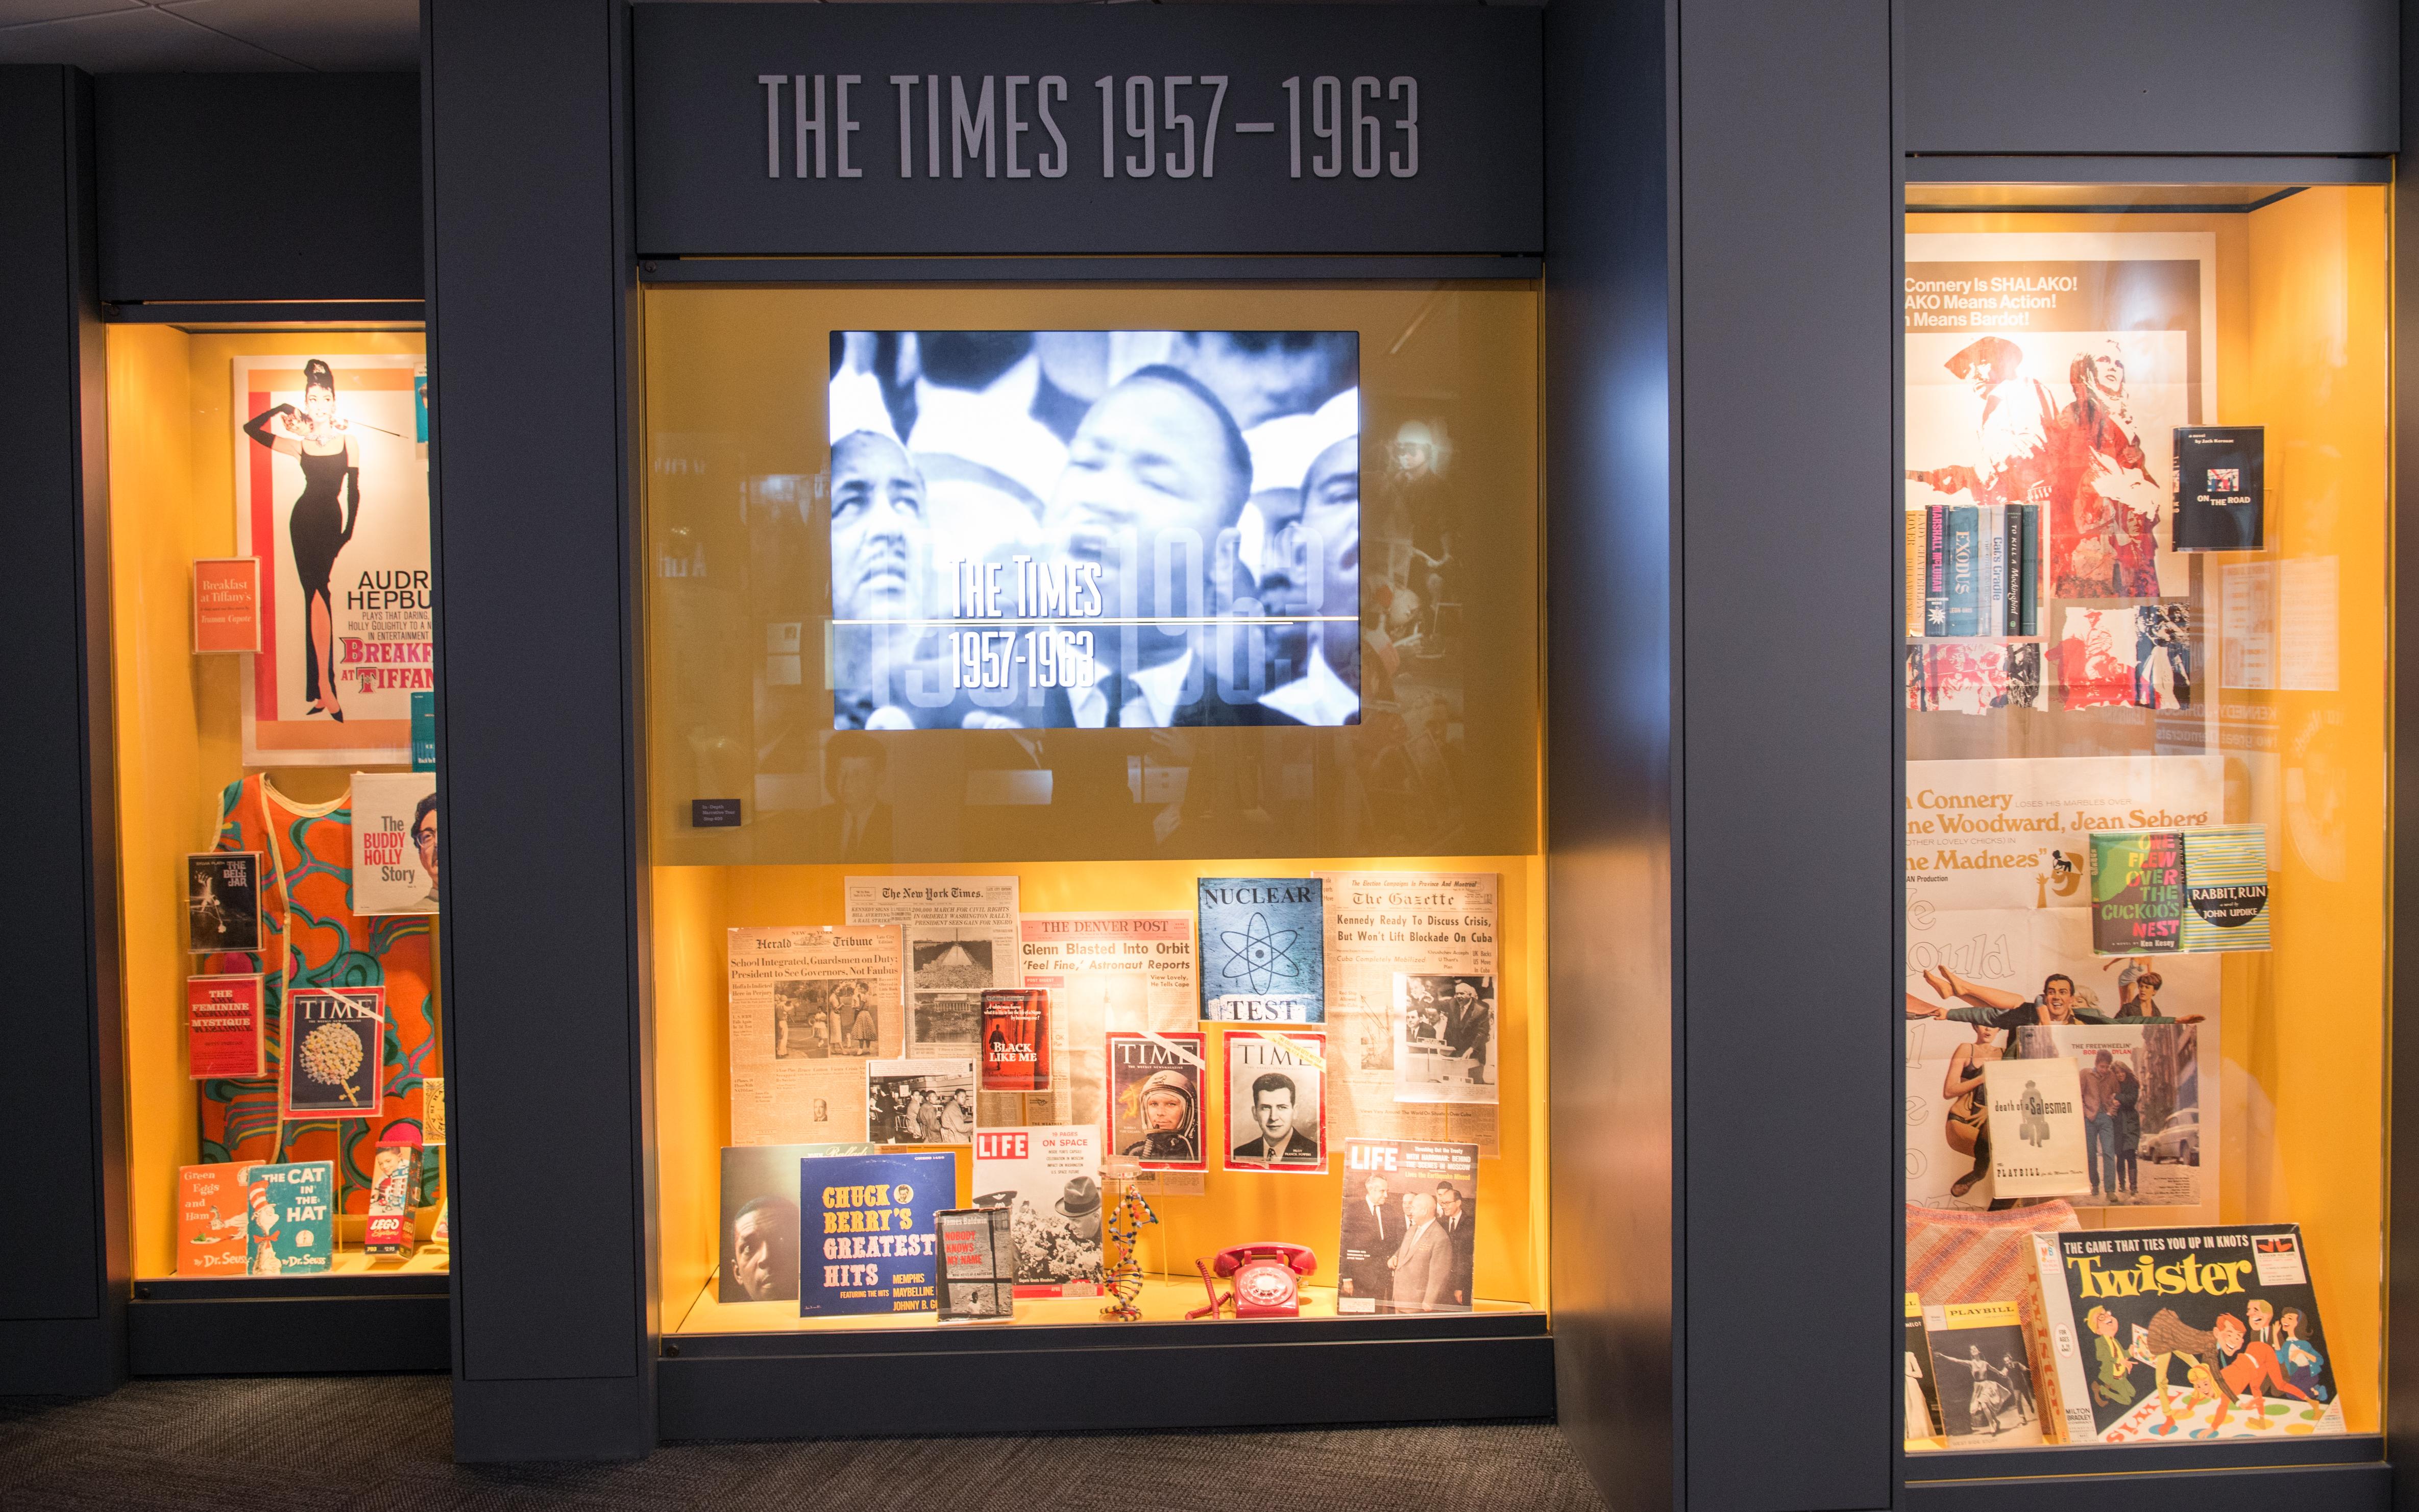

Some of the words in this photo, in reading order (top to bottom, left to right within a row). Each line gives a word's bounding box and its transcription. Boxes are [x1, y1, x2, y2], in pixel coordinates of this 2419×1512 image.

[759, 75, 862, 178] THE
[891, 75, 1068, 178] TIMES
[1904, 278, 1971, 295] Connery
[1974, 278, 1987, 291] Is
[1991, 277, 2077, 292] SHALAKO!
[1944, 295, 1997, 309] Means
[1999, 294, 2057, 308] Action!
[1914, 312, 1967, 326] Means
[1970, 312, 2030, 326] Bardot!
[1932, 505, 1942, 550] MARSHALL
[1993, 537, 2002, 563] Cat's
[1955, 531, 1969, 594] EXODUS
[203, 579, 247, 590] Breakfast
[949, 556, 1001, 617] THE
[1013, 554, 1102, 617] TIMES
[1993, 566, 2002, 601] Cradle
[212, 592, 251, 602] Tiffany's
[362, 612, 382, 620] PLAYS
[386, 612, 401, 620] THAT
[404, 612, 430, 620] DARING,
[368, 632, 374, 640] IN
[377, 632, 429, 640] ENTERTAINMENT
[949, 630, 1094, 688] 1957-1963
[341, 670, 355, 680] AT
[1919, 790, 2013, 810] Connery
[381, 816, 404, 832] The
[1937, 813, 2065, 834] Woodward,
[2071, 813, 2123, 832] Jean
[2129, 809, 2208, 829] Seberg
[364, 833, 405, 848] BUDDY
[2139, 835, 2175, 849] ONE
[364, 849, 402, 865] HOLLY
[2129, 852, 2177, 868] FLEW
[224, 869, 246, 878] BELL
[382, 866, 414, 883] Story
[2127, 869, 2178, 886] OVER
[228, 877, 248, 887] JAR
[882, 887, 901, 899] The
[903, 888, 923, 898] New
[925, 887, 948, 900] York
[1205, 887, 1312, 905] NUCLEAR
[1353, 893, 1382, 905] The
[1389, 893, 1454, 905] Gazette
[2140, 885, 2178, 901] THE
[2192, 888, 2237, 900] RABBIT,
[2239, 887, 2266, 897] RUN
[2102, 901, 2179, 920] CUCKOO'S
[2203, 910, 2227, 918] JOHN
[2230, 908, 2258, 916] UPDIKE
[1042, 922, 1069, 932] THE
[1074, 921, 1128, 932] DENVER
[1134, 921, 1168, 931] POST
[1337, 915, 1374, 926] Kennedy
[1381, 916, 1406, 926] Ready
[1412, 916, 1422, 924] To
[1428, 916, 1458, 925] Discuss
[1465, 916, 1491, 927] Crisis,
[1338, 931, 1352, 940] But
[1358, 931, 1385, 941] Won't
[1390, 931, 1404, 941] Lift
[1410, 932, 1449, 942] Blockade
[1454, 933, 1465, 942] On
[1472, 933, 1492, 942] Cuba
[2133, 920, 2179, 938] NEST
[755, 939, 791, 949] Herald
[833, 937, 872, 946] Tribune
[1023, 944, 1059, 955] Glenn
[1067, 943, 1115, 954] Blasted
[1124, 943, 1148, 954] Into
[1157, 943, 1189, 954] Orbit
[731, 959, 760, 967] School
[762, 957, 809, 968] Integrated,
[810, 956, 860, 965] Guardsmen
[192, 1003, 249, 1011] FEMININE
[300, 999, 372, 1019] TIME
[1227, 1001, 1297, 1020] TEST
[192, 1018, 250, 1027] MYSTIQUE
[993, 1042, 1032, 1052] BLACK
[1118, 1044, 1193, 1064] TIME
[989, 1053, 1016, 1061] LIKE
[1019, 1053, 1037, 1061] ME
[1995, 1101, 2015, 1112] death
[2017, 1100, 2023, 1111] of
[2030, 1097, 2072, 1115] Salesman
[979, 1135, 1025, 1157] LIFE
[1352, 1146, 1398, 1171] LIFE
[184, 1172, 215, 1181] Green
[262, 1174, 285, 1183] THE
[288, 1168, 325, 1184] CAT
[193, 1184, 219, 1196] Eggs
[822, 1184, 890, 1208] CHUCK
[185, 1199, 205, 1208] and
[186, 1212, 209, 1221] Ham
[287, 1206, 327, 1222] HAT
[823, 1208, 913, 1234] BERRY'S
[370, 1218, 399, 1230] LEGO
[945, 1231, 976, 1241] NOBODY
[824, 1234, 936, 1259] GREATEST
[946, 1243, 974, 1253] KNOWS
[2064, 1241, 2083, 1254] THE
[2085, 1240, 2112, 1253] GAME
[2115, 1239, 2139, 1252] THAT
[2142, 1238, 2165, 1250] TIES
[2167, 1238, 2186, 1250] YOU
[2188, 1237, 2201, 1248] UP
[2204, 1236, 2214, 1248] IN
[2217, 1235, 2249, 1248] KNOTS
[947, 1256, 960, 1265] MY
[961, 1255, 982, 1264] NAME
[823, 1263, 878, 1287] HITS
[893, 1274, 924, 1284] MEMPHIS
[2067, 1255, 2252, 1299] Twister
[893, 1286, 934, 1297] MAYBELLINE
[1950, 1306, 2014, 1315] PLAYBILL
